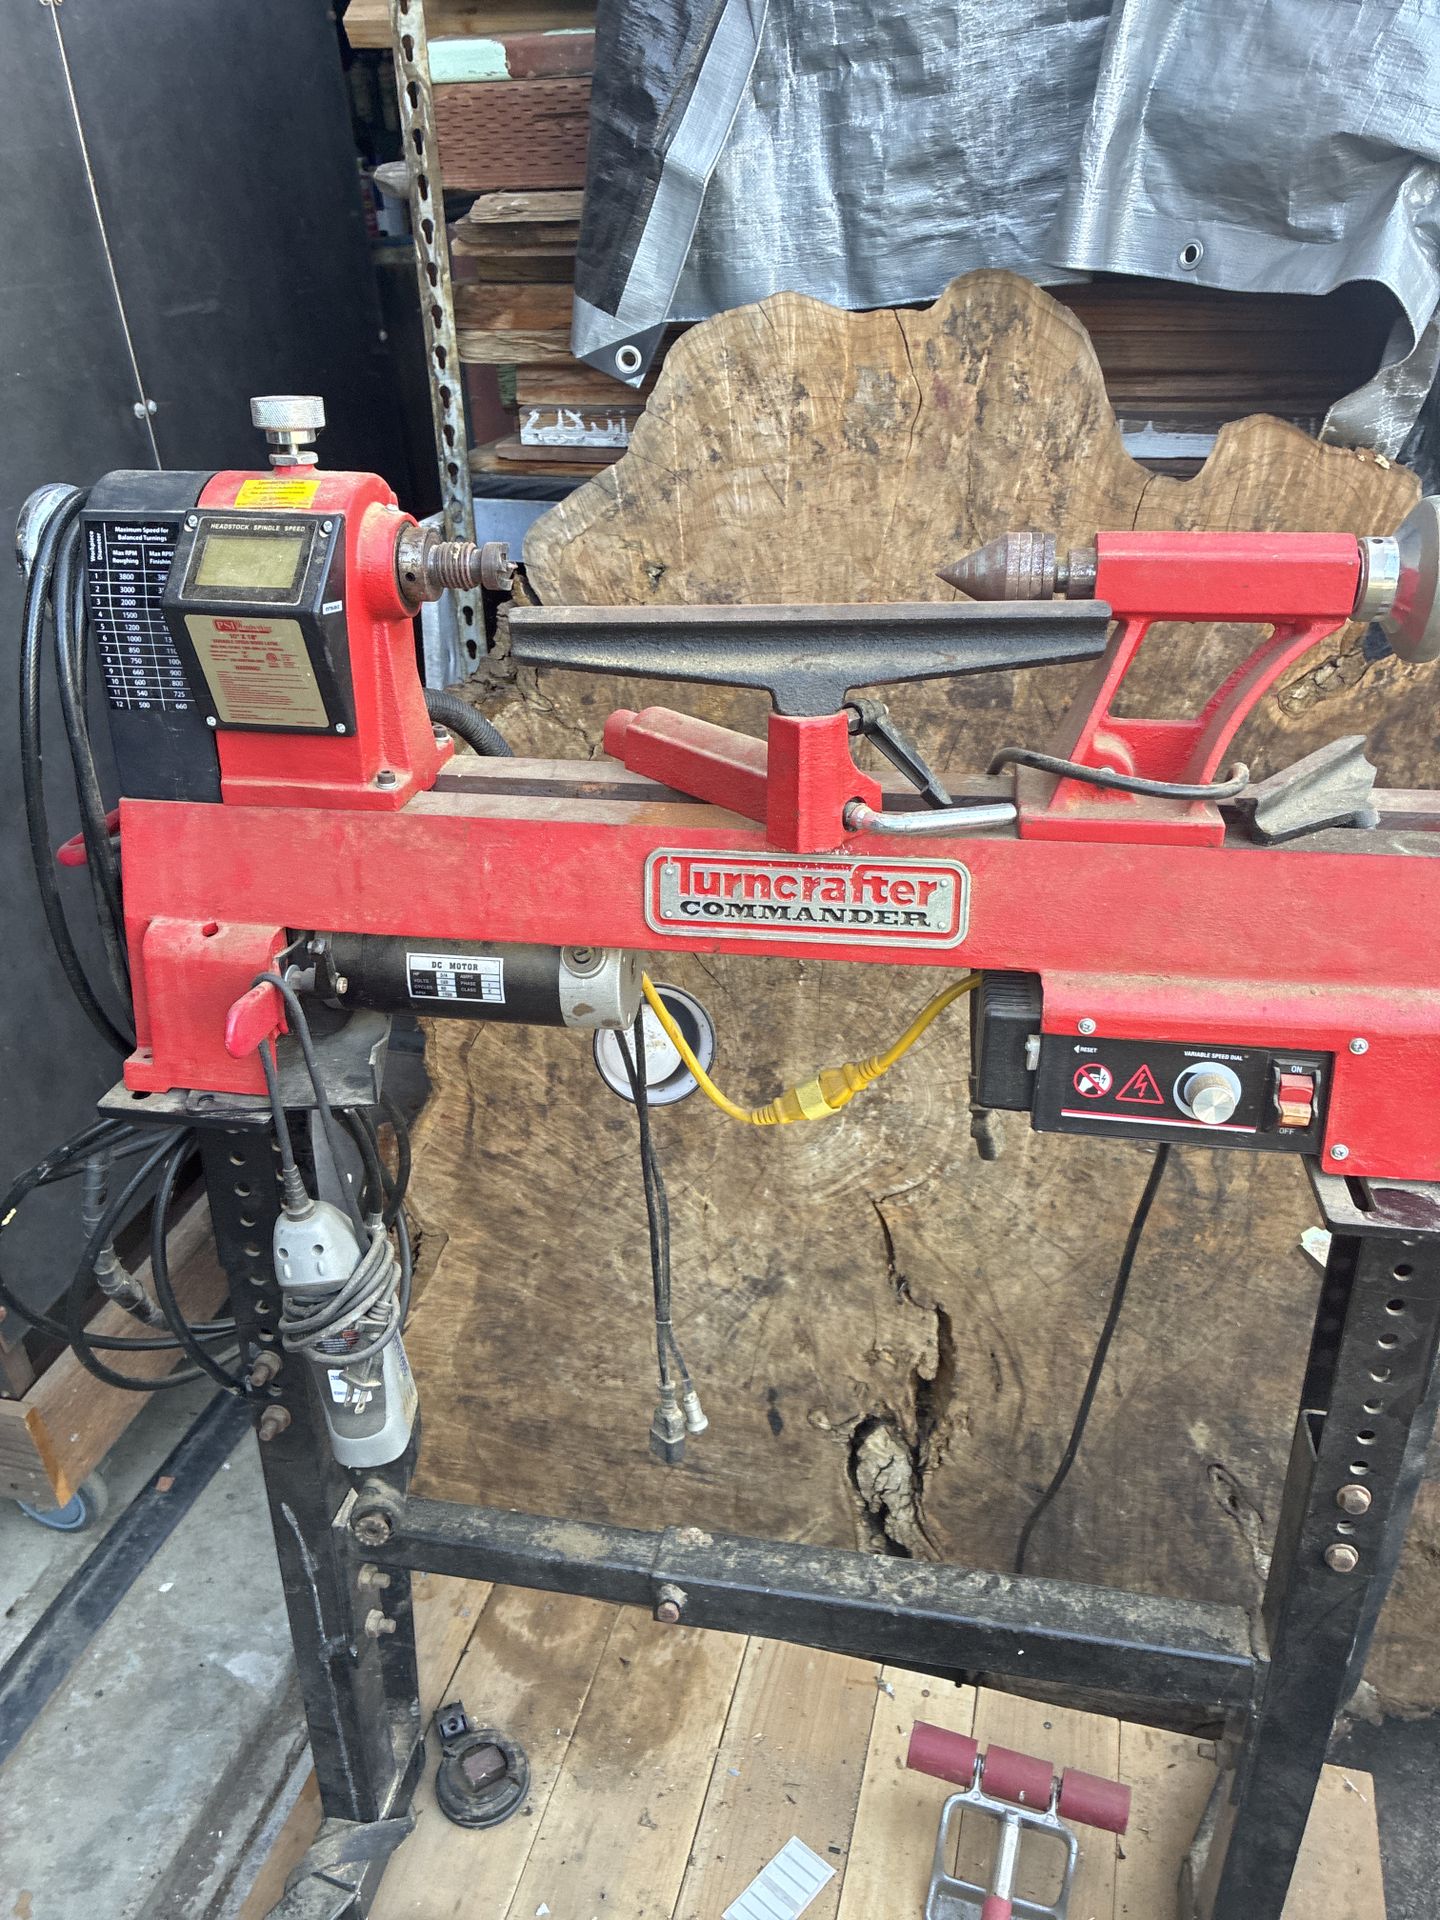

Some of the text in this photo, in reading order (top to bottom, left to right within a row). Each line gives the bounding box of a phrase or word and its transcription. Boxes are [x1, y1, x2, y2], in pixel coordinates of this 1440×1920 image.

[216, 621, 236, 630] PSI
[676, 860, 938, 907] Turncrafter
[680, 900, 931, 928] COMMANDER
[450, 962, 478, 970] MOTOR
[1184, 1050, 1210, 1059] VARIABLE
[1291, 1065, 1303, 1073] ON
